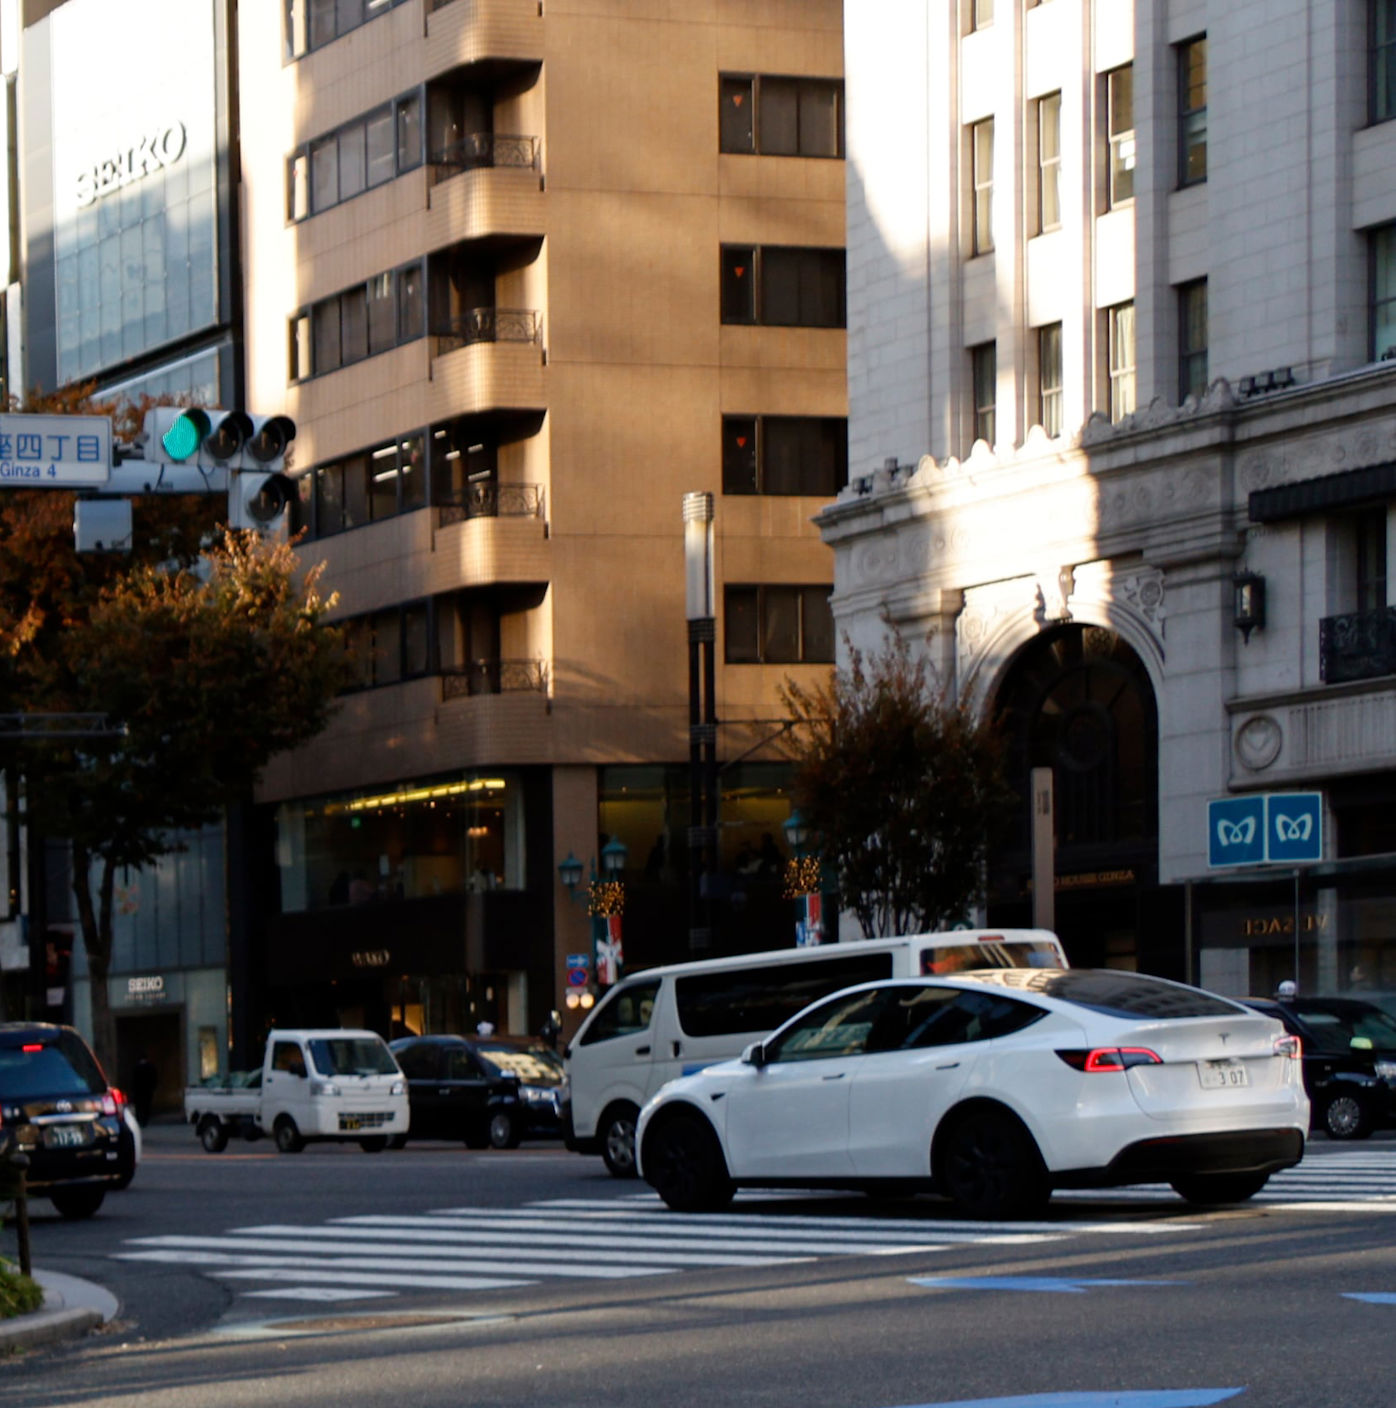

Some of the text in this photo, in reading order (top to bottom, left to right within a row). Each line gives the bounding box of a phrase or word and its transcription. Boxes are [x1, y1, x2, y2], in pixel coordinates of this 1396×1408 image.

[0, 461, 57, 478] Ginza 4
[128, 976, 164, 992] SEIKO
